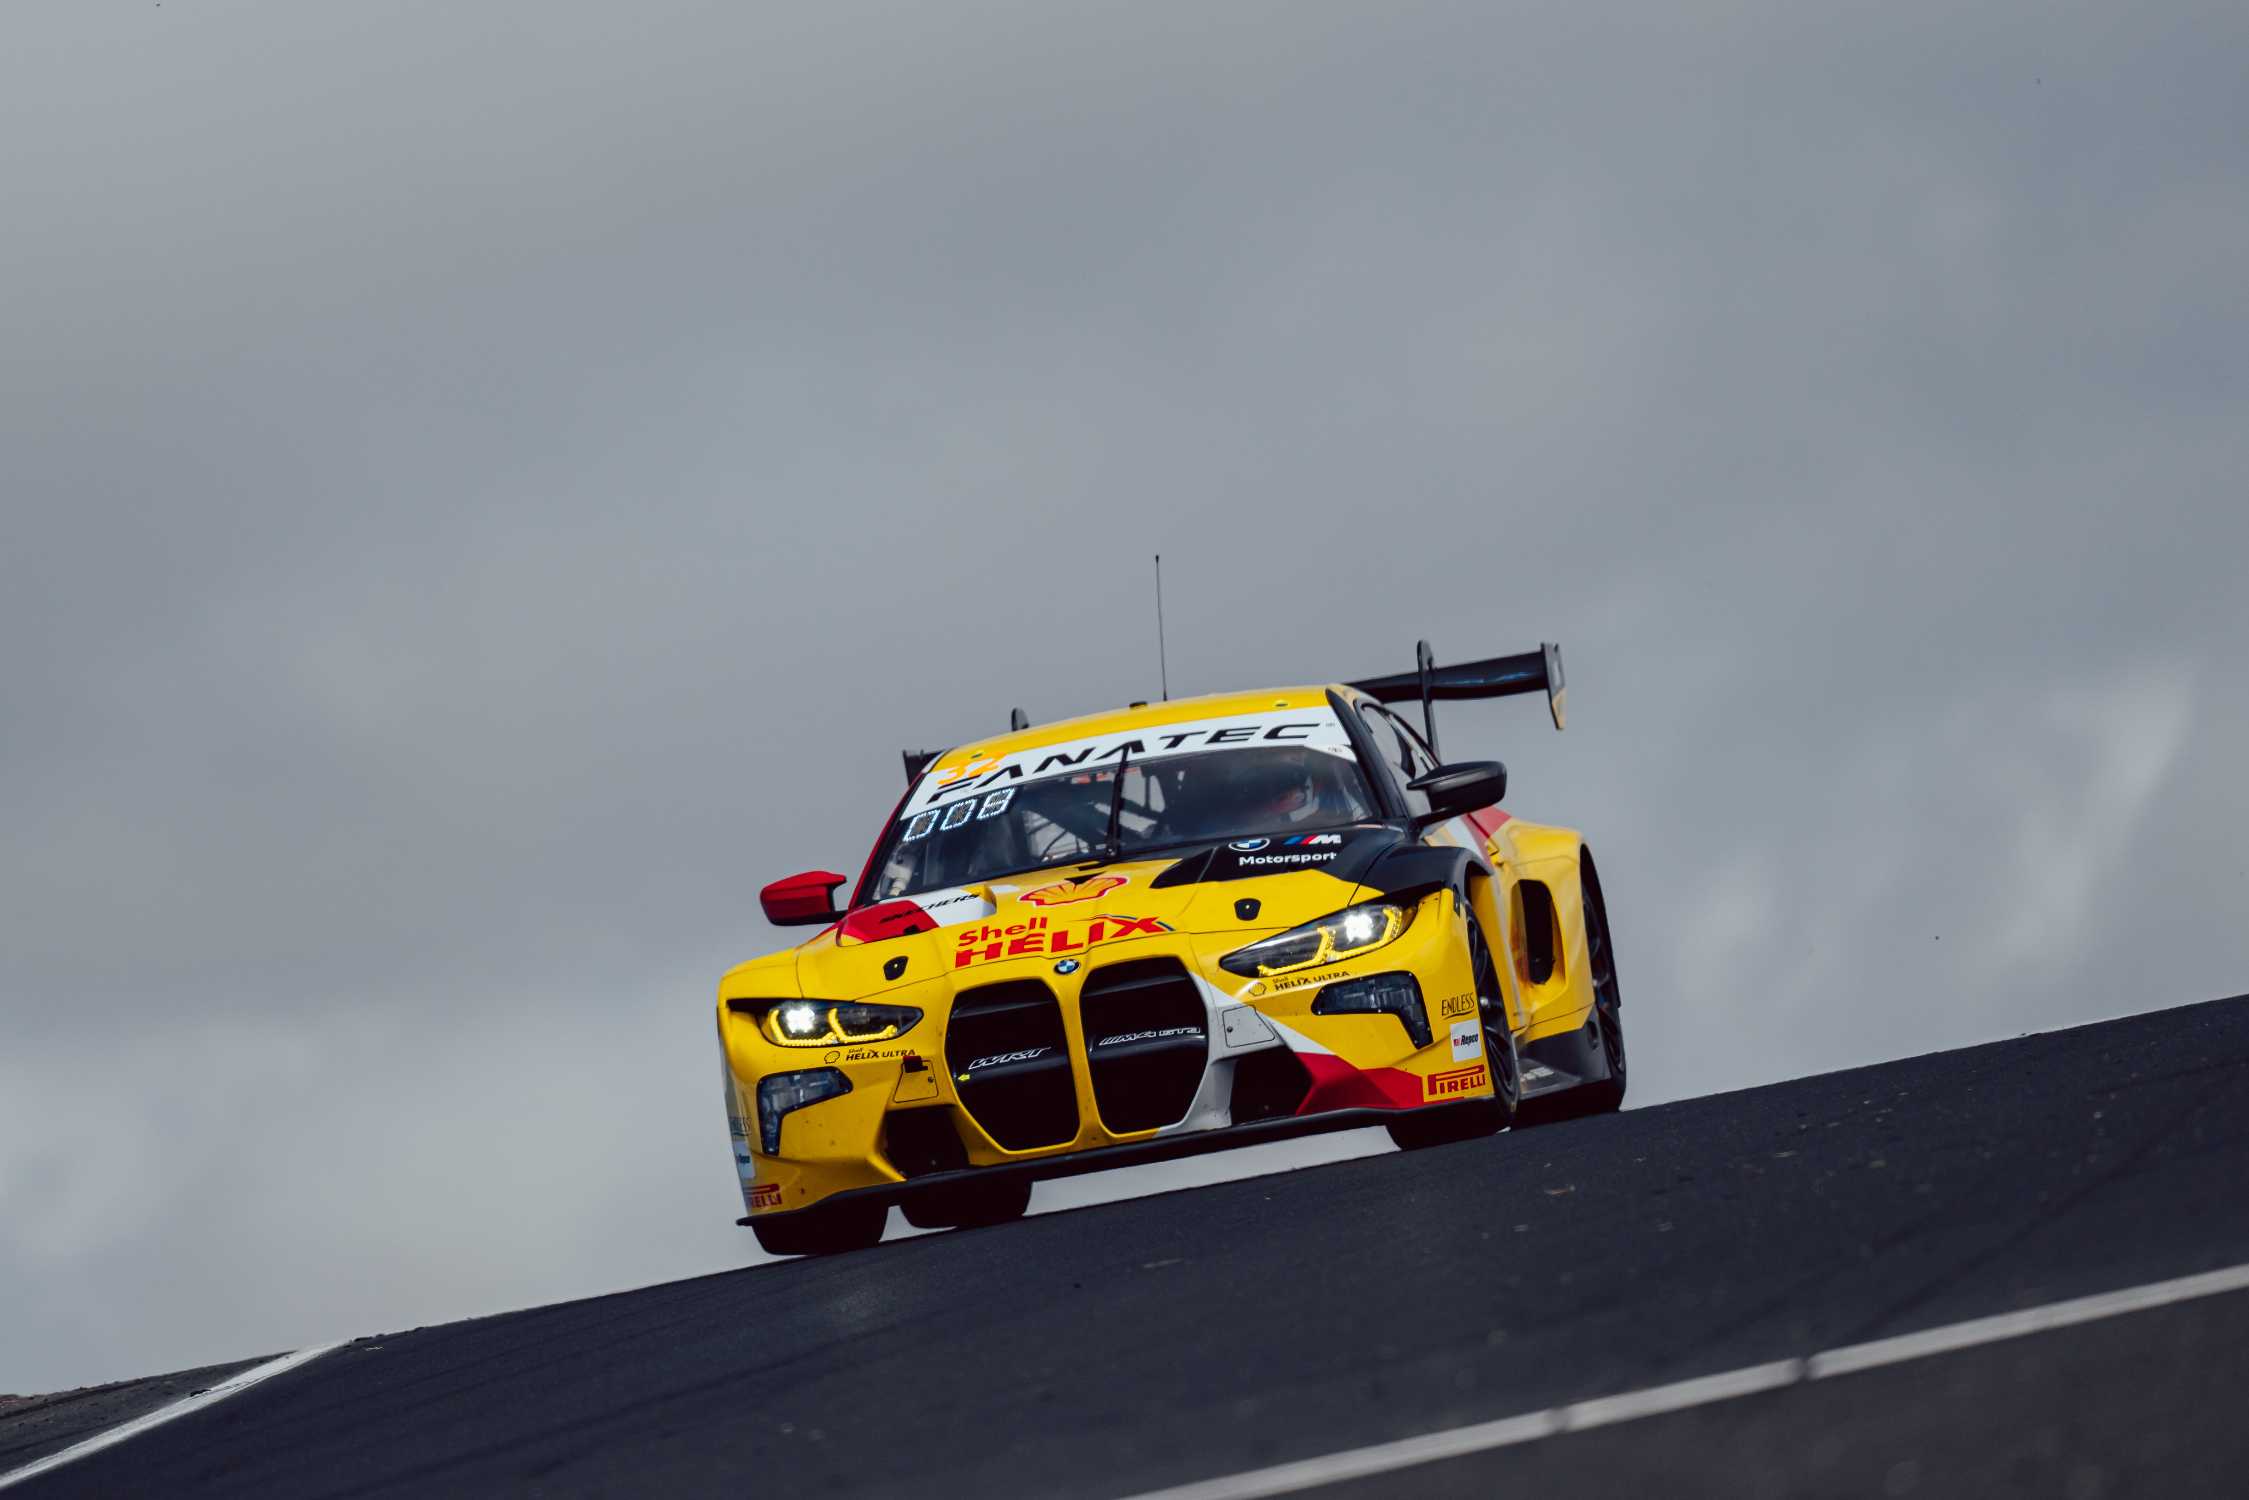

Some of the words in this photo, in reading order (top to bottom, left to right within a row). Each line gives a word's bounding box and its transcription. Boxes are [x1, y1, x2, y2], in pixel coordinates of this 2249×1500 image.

[926, 723, 1320, 804] FANATEC
[1239, 852, 1337, 867] Motorsport
[955, 914, 1167, 968] HELIX
[958, 917, 1048, 947] Shell
[1274, 978, 1311, 991] HELIX
[1314, 970, 1350, 982] ULTRA
[1441, 992, 1475, 1017] ENDLESS
[846, 1049, 880, 1061] HELIX
[882, 1049, 916, 1058] ULTRA
[1427, 1063, 1486, 1096] PIRELLI
